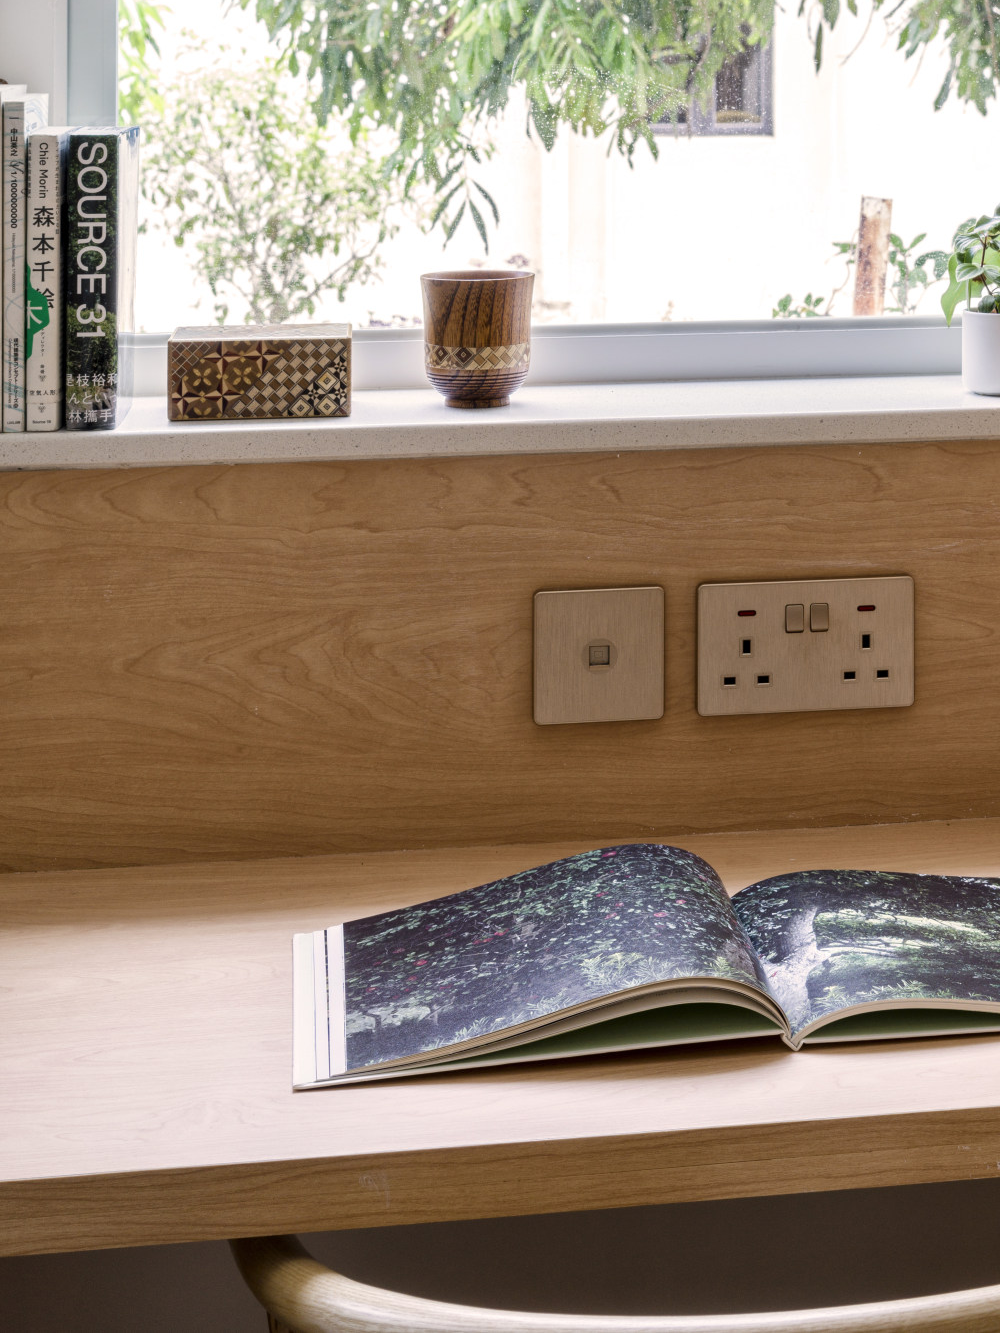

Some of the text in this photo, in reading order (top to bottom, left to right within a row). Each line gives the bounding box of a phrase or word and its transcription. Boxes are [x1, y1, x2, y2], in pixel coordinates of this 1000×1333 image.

[39, 142, 48, 199] Chie Morin
[76, 141, 108, 339] SOURCE 31
